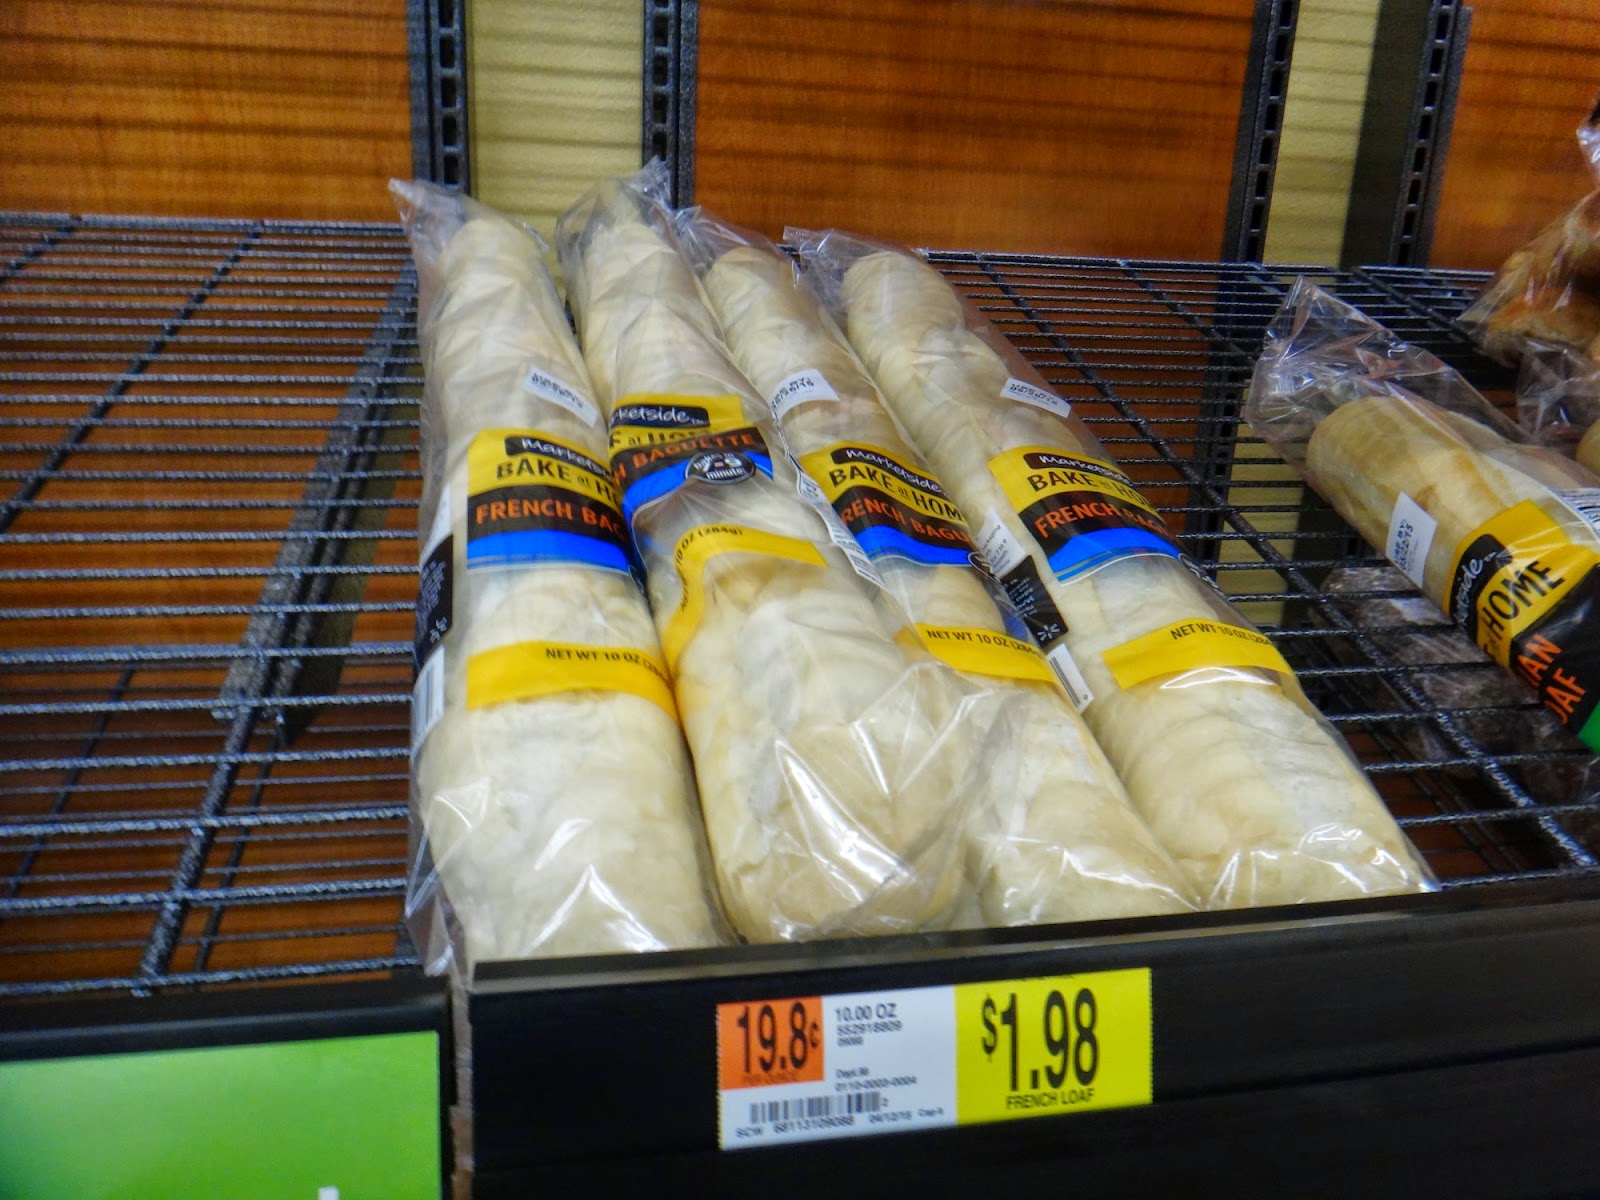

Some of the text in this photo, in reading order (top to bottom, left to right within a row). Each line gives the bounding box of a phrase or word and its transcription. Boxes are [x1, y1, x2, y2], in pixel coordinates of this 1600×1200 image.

[632, 433, 757, 469] BAGUETTE
[496, 456, 572, 485] BAKE
[1027, 470, 1100, 493] BAKE
[828, 464, 896, 491] BAKE
[911, 491, 964, 522] HOM
[475, 498, 573, 526] FRENCH
[840, 497, 908, 526] RENCH
[1034, 502, 1121, 539] FRENCH
[911, 518, 971, 543] BAGU
[1482, 561, 1565, 641] HOME
[926, 629, 951, 640] NET
[951, 631, 974, 642] WT
[976, 633, 992, 645] 10
[993, 635, 1011, 648] OZ
[1170, 622, 1197, 641] NET
[1195, 622, 1218, 634] WT
[1218, 626, 1234, 637] 10
[545, 647, 641, 665] NET WT 10 OZ
[835, 1002, 898, 1021] 10.00 OZ
[981, 987, 1099, 1092] $1.98
[1006, 1088, 1096, 1110] FRENCH LOAF
